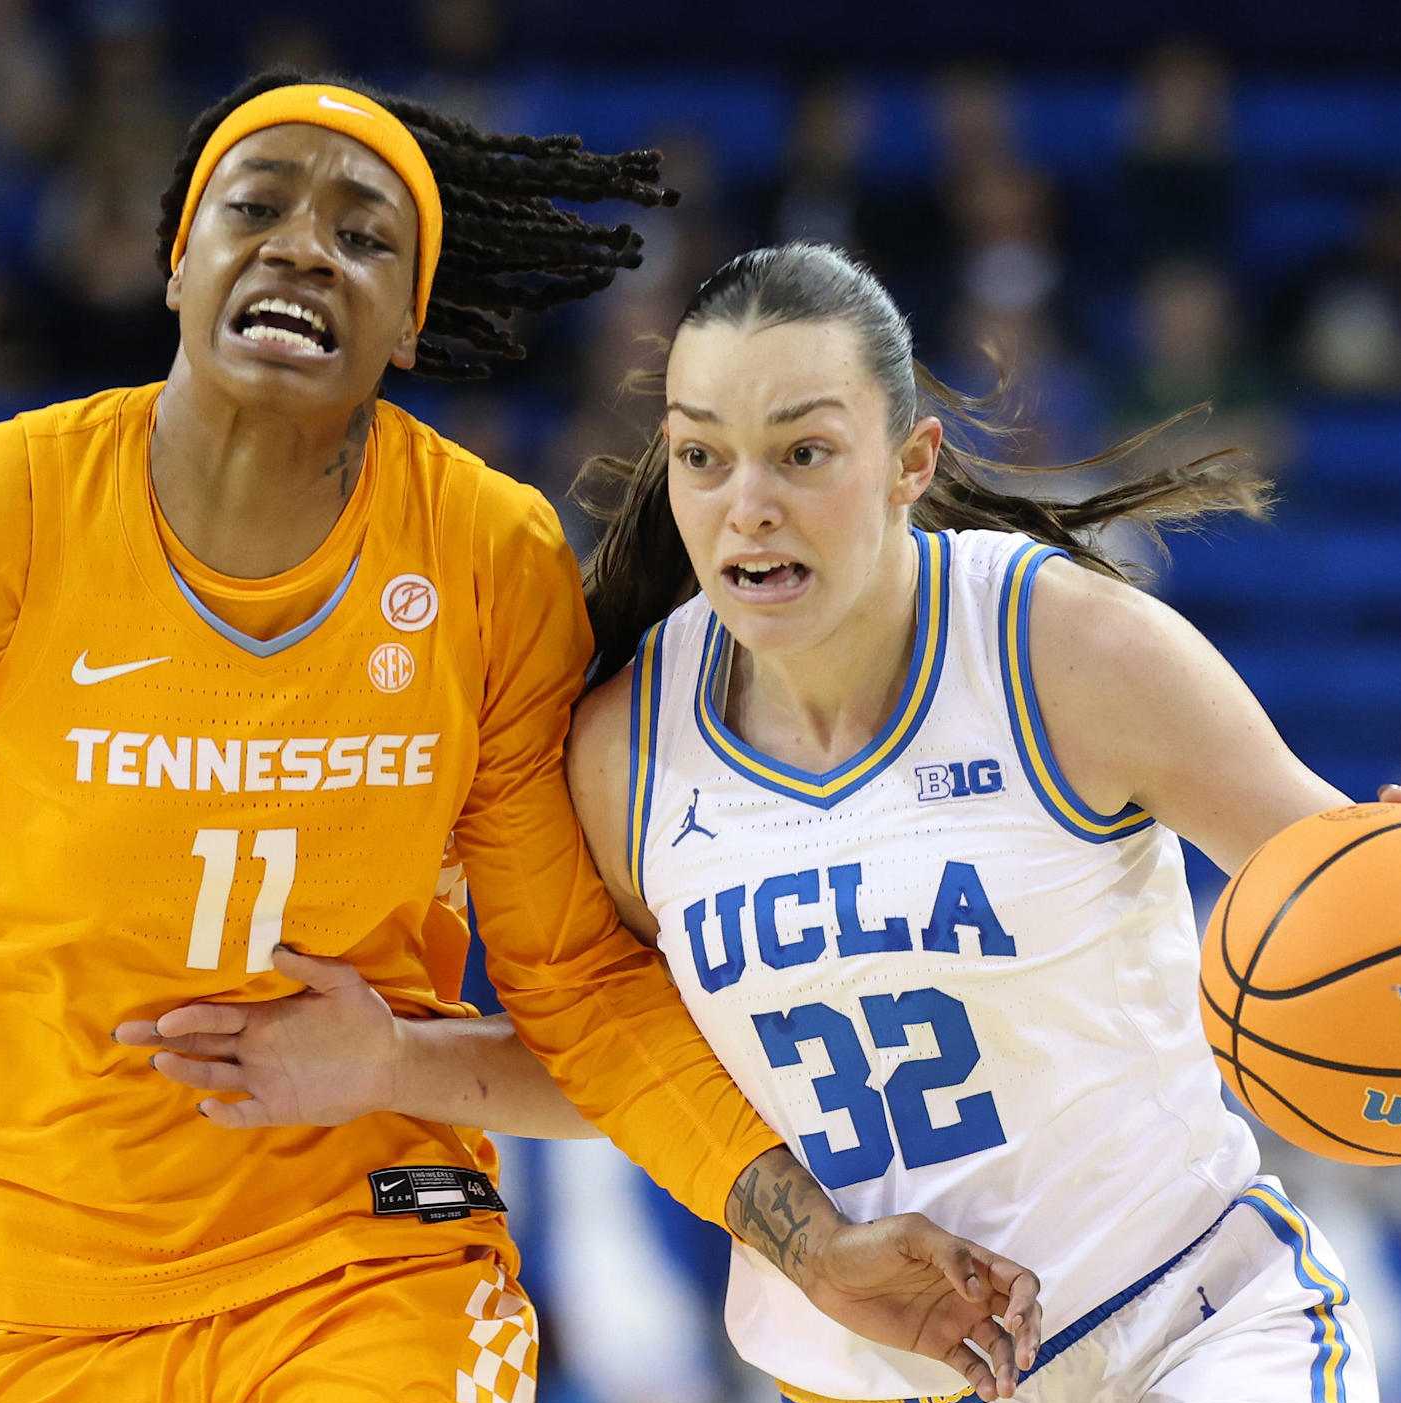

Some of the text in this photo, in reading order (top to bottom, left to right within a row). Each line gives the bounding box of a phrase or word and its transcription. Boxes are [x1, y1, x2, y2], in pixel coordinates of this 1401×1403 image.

[373, 648, 410, 688] SEC
[64, 727, 441, 793] TENNESSEE
[186, 828, 297, 974] 11
[684, 861, 1017, 994] UCLA
[751, 987, 1007, 1190] 32
[381, 1194, 412, 1204] TEAM
